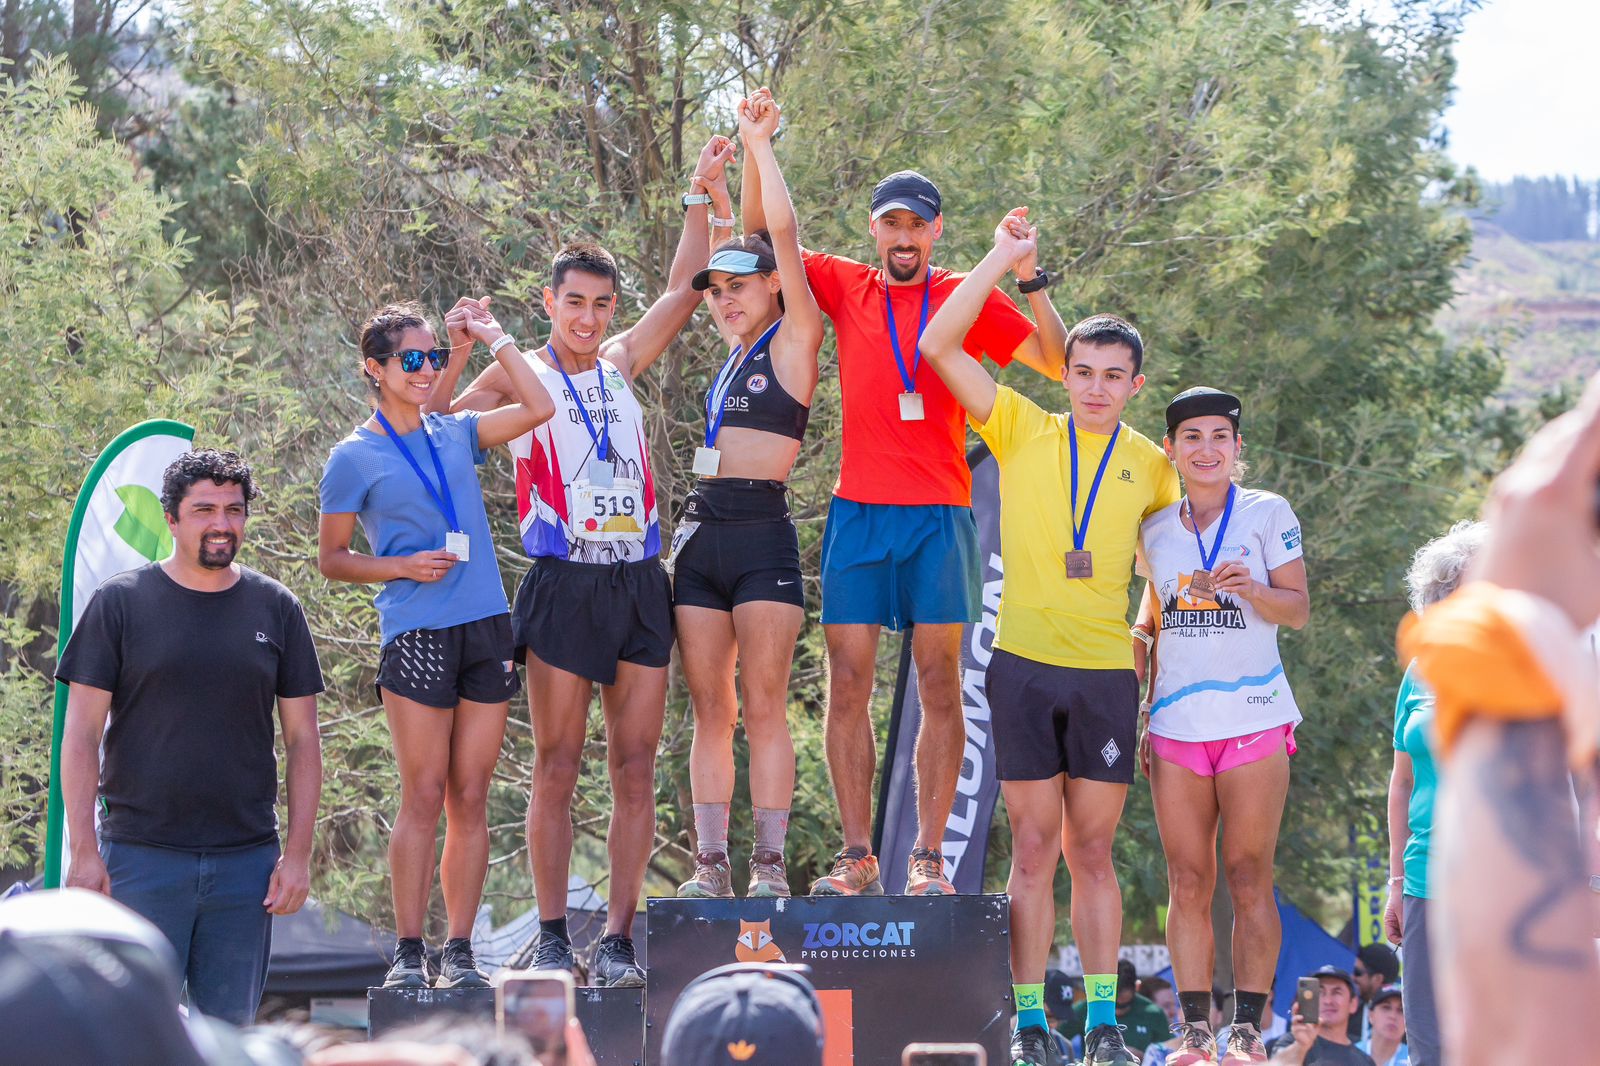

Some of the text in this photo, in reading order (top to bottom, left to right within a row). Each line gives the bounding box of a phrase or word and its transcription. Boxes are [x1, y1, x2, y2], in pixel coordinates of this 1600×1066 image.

[594, 495, 635, 517] 519
[1199, 628, 1208, 638] IN
[1247, 696, 1274, 706] cmpc
[803, 921, 915, 949] ZORCAT
[801, 949, 916, 959] PRODUCCIONES
